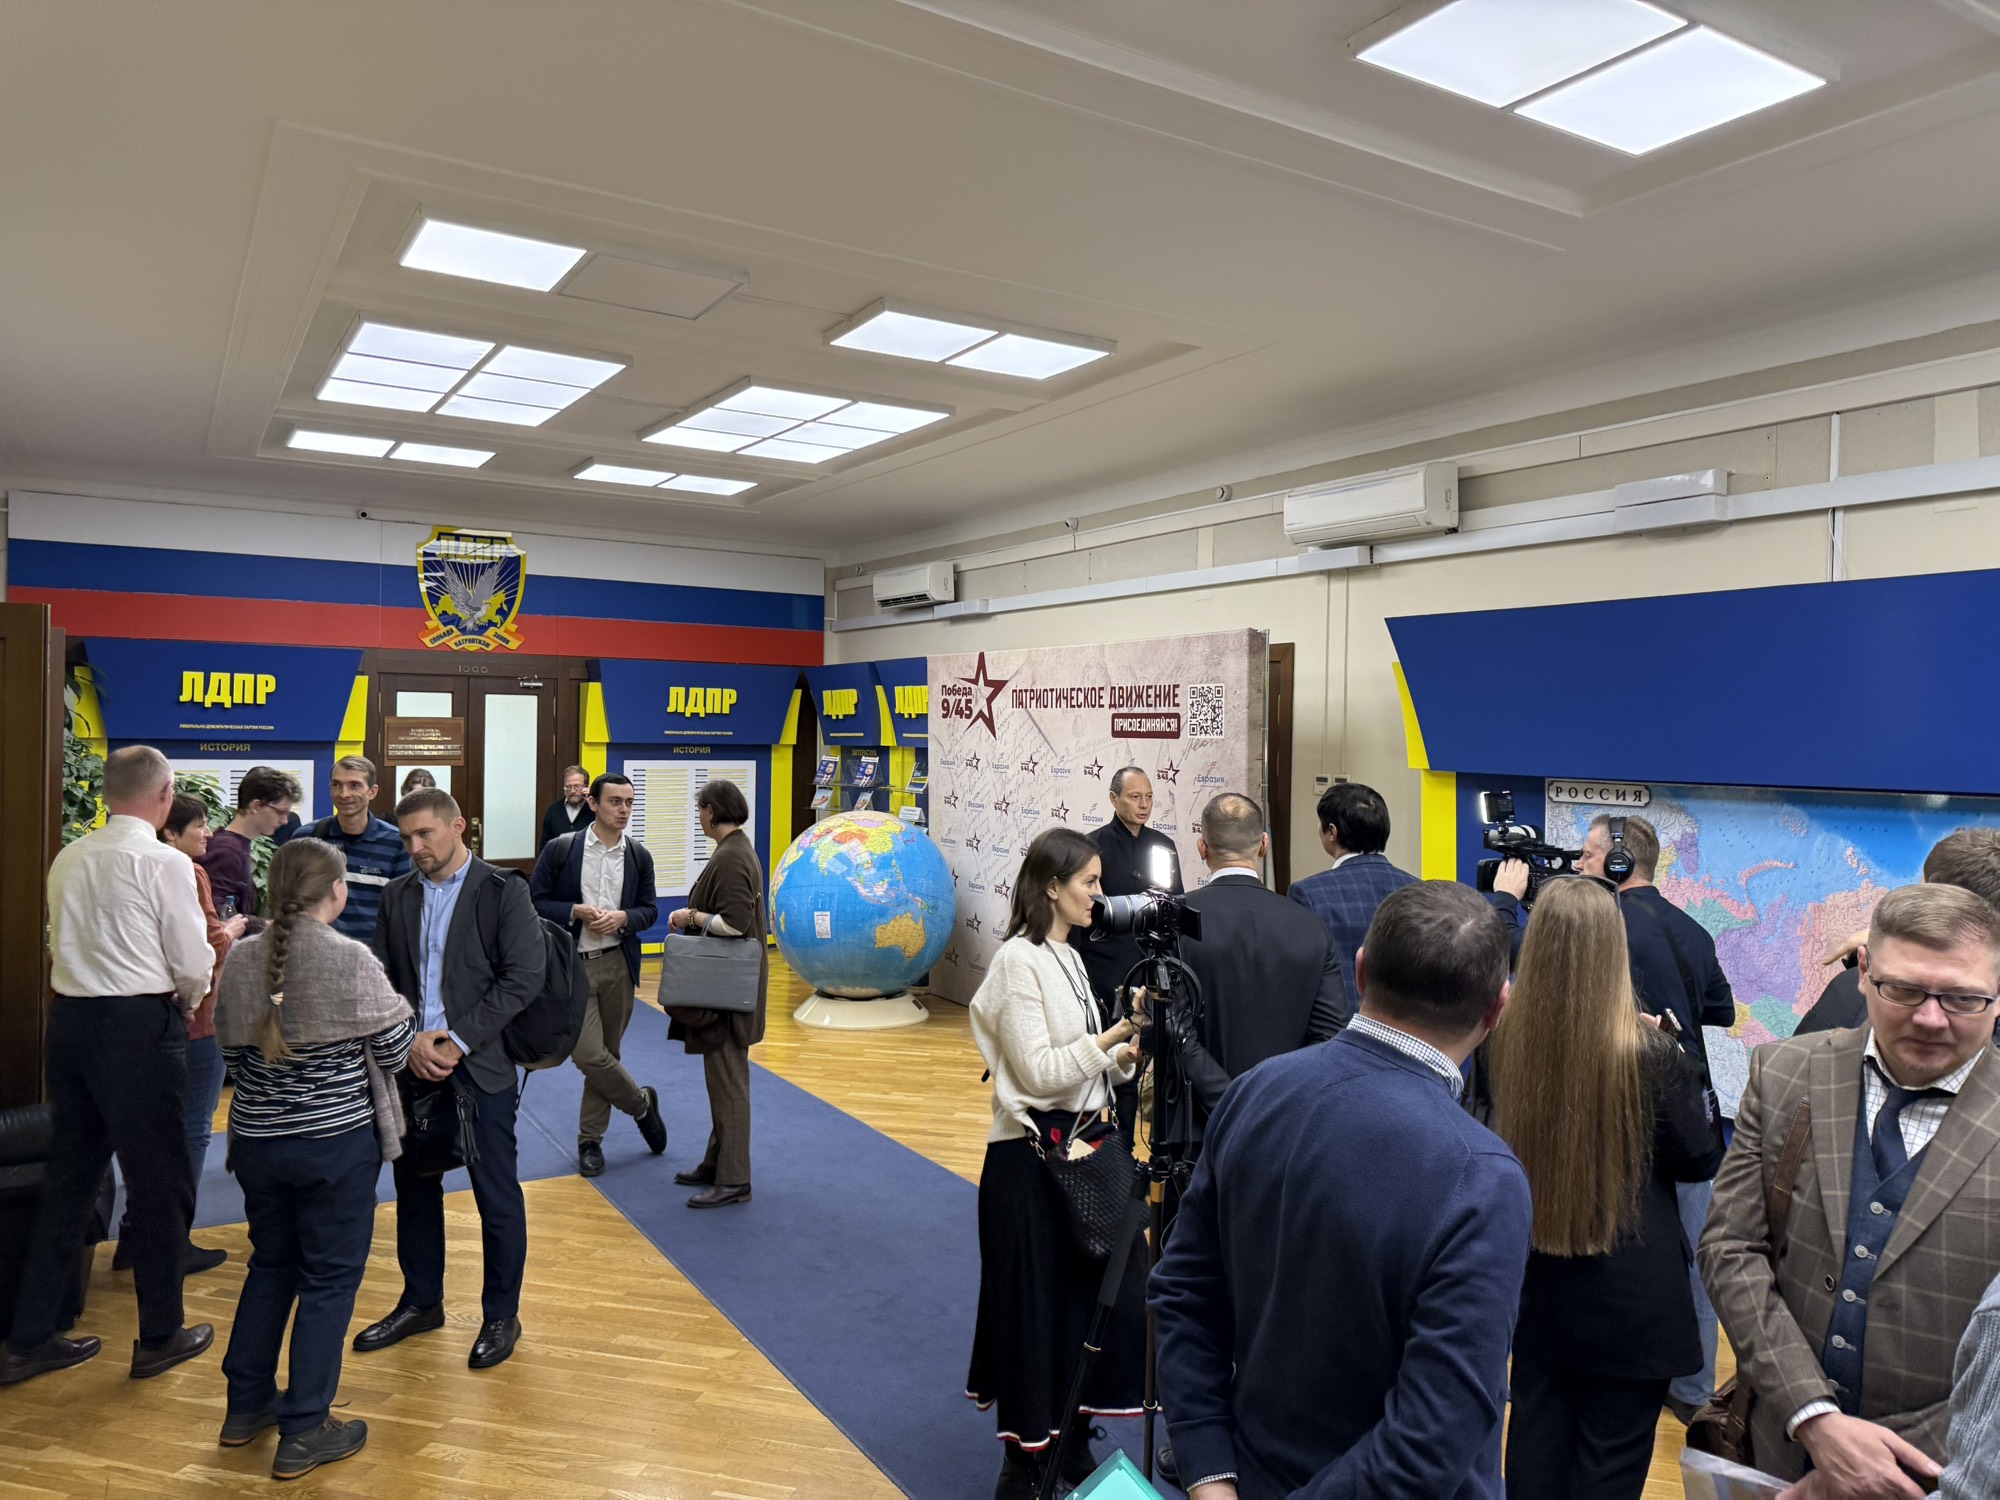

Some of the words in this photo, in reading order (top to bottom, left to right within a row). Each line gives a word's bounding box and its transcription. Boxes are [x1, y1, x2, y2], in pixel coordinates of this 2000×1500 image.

[179, 671, 276, 708] ЛДПР
[941, 684, 973, 697] Победа
[666, 686, 738, 717] ЛДПР
[822, 688, 858, 719] ЛДПР
[1011, 686, 1105, 709] ПАТРИОТИЧЕСКОЕ
[1108, 684, 1181, 710] ДВИЖЕНИЕ
[941, 698, 974, 719] 9/45
[1114, 716, 1178, 733] ПРИСОЕДИНЯЙСЯ!
[200, 743, 251, 751] ИСТОРИЯ
[673, 746, 711, 754] ИСТОРИЯ
[1050, 766, 1071, 774] Евразия
[1197, 773, 1225, 783] Евразия
[1555, 786, 1643, 801] РОССИЯ
[1082, 813, 1104, 822] Евразия
[1152, 820, 1177, 830] Евразия
